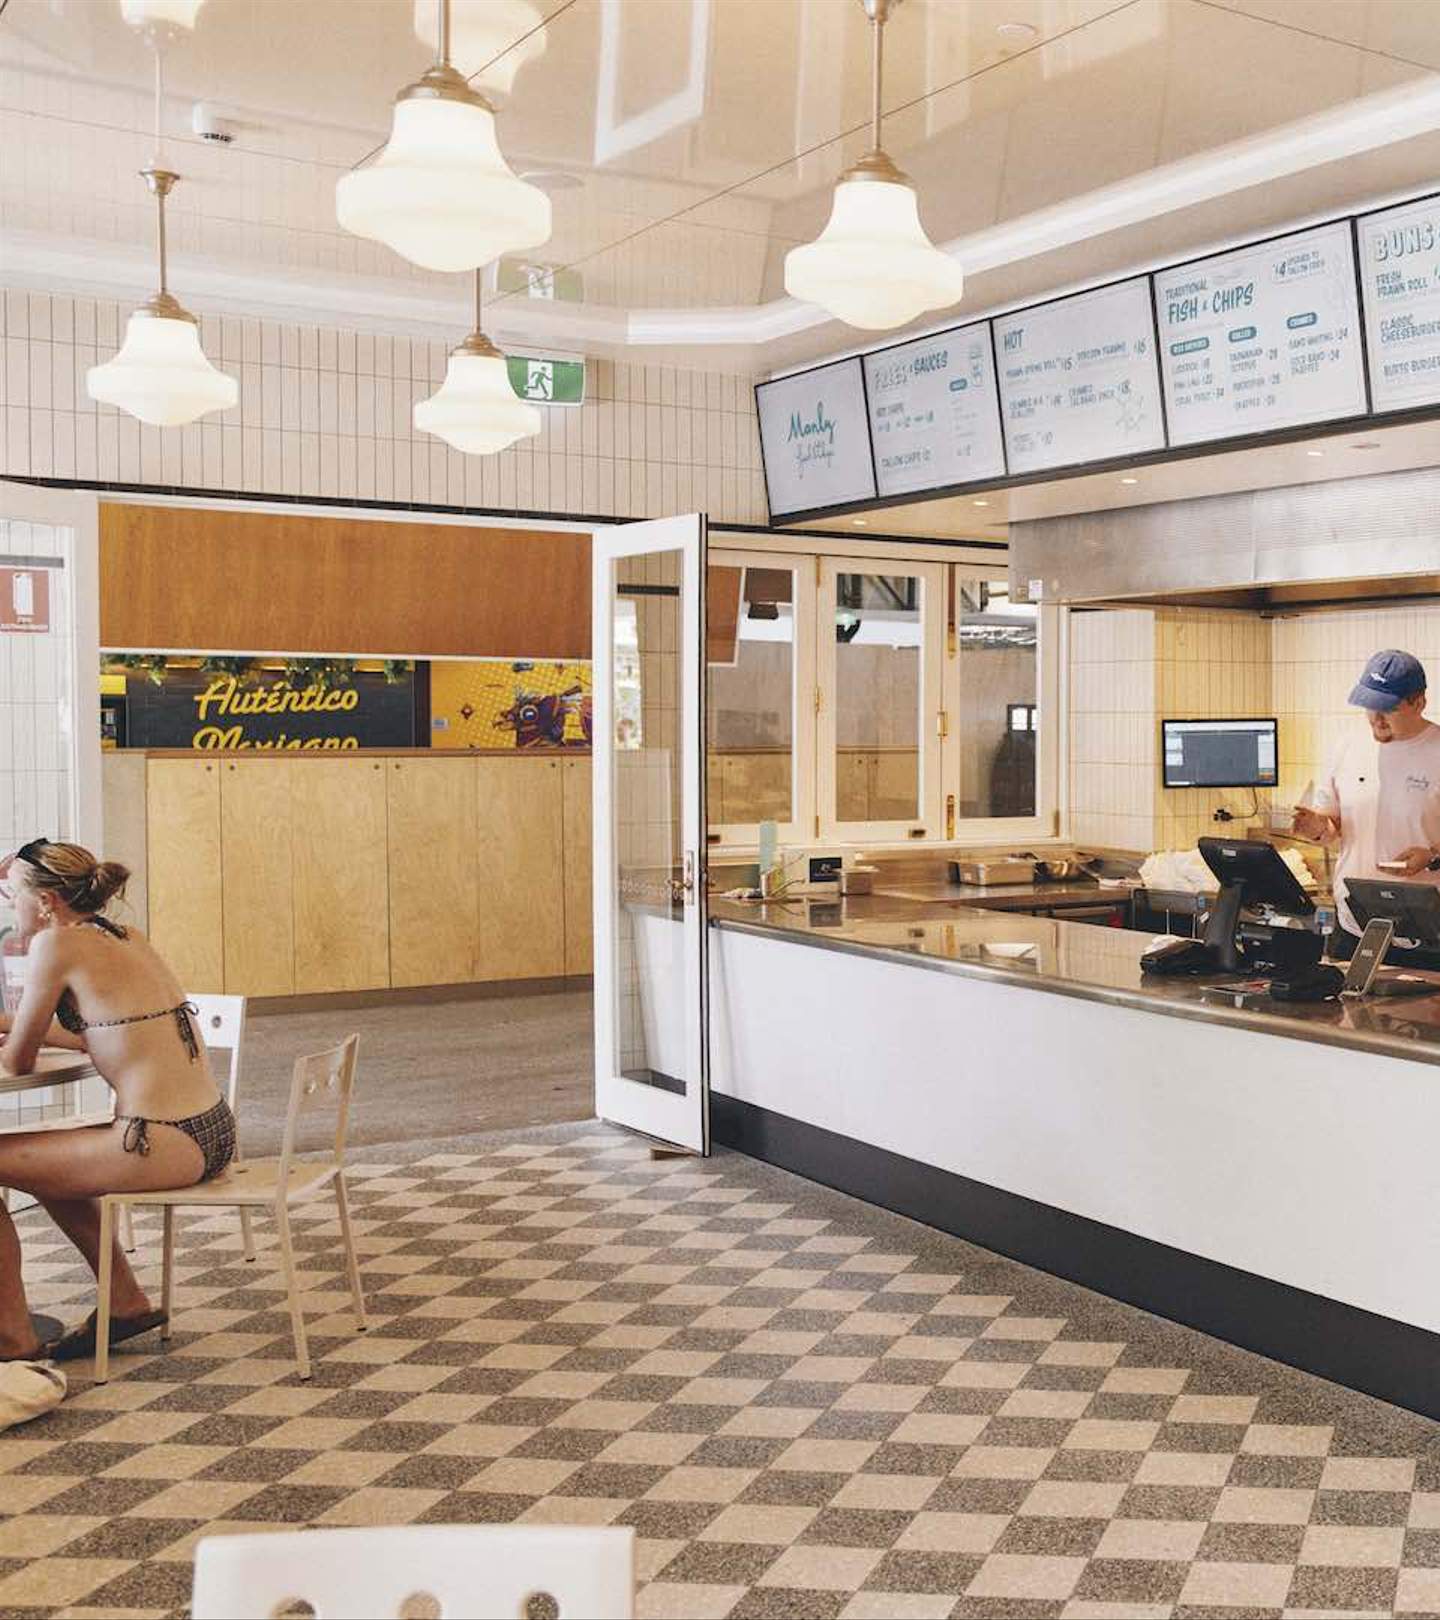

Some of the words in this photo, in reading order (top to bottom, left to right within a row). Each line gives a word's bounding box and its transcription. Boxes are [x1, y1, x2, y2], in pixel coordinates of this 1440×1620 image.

[1376, 221, 1435, 263] BUNS
[1165, 278, 1208, 301] TRADITIONAL
[1407, 277, 1429, 292] ROLL
[1168, 296, 1199, 325] FISH
[1212, 282, 1255, 314] CHIPS
[1004, 328, 1025, 352] HOT
[914, 350, 949, 377] SAUCES
[787, 400, 837, 445] Manly
[193, 675, 360, 721] Auténtico
